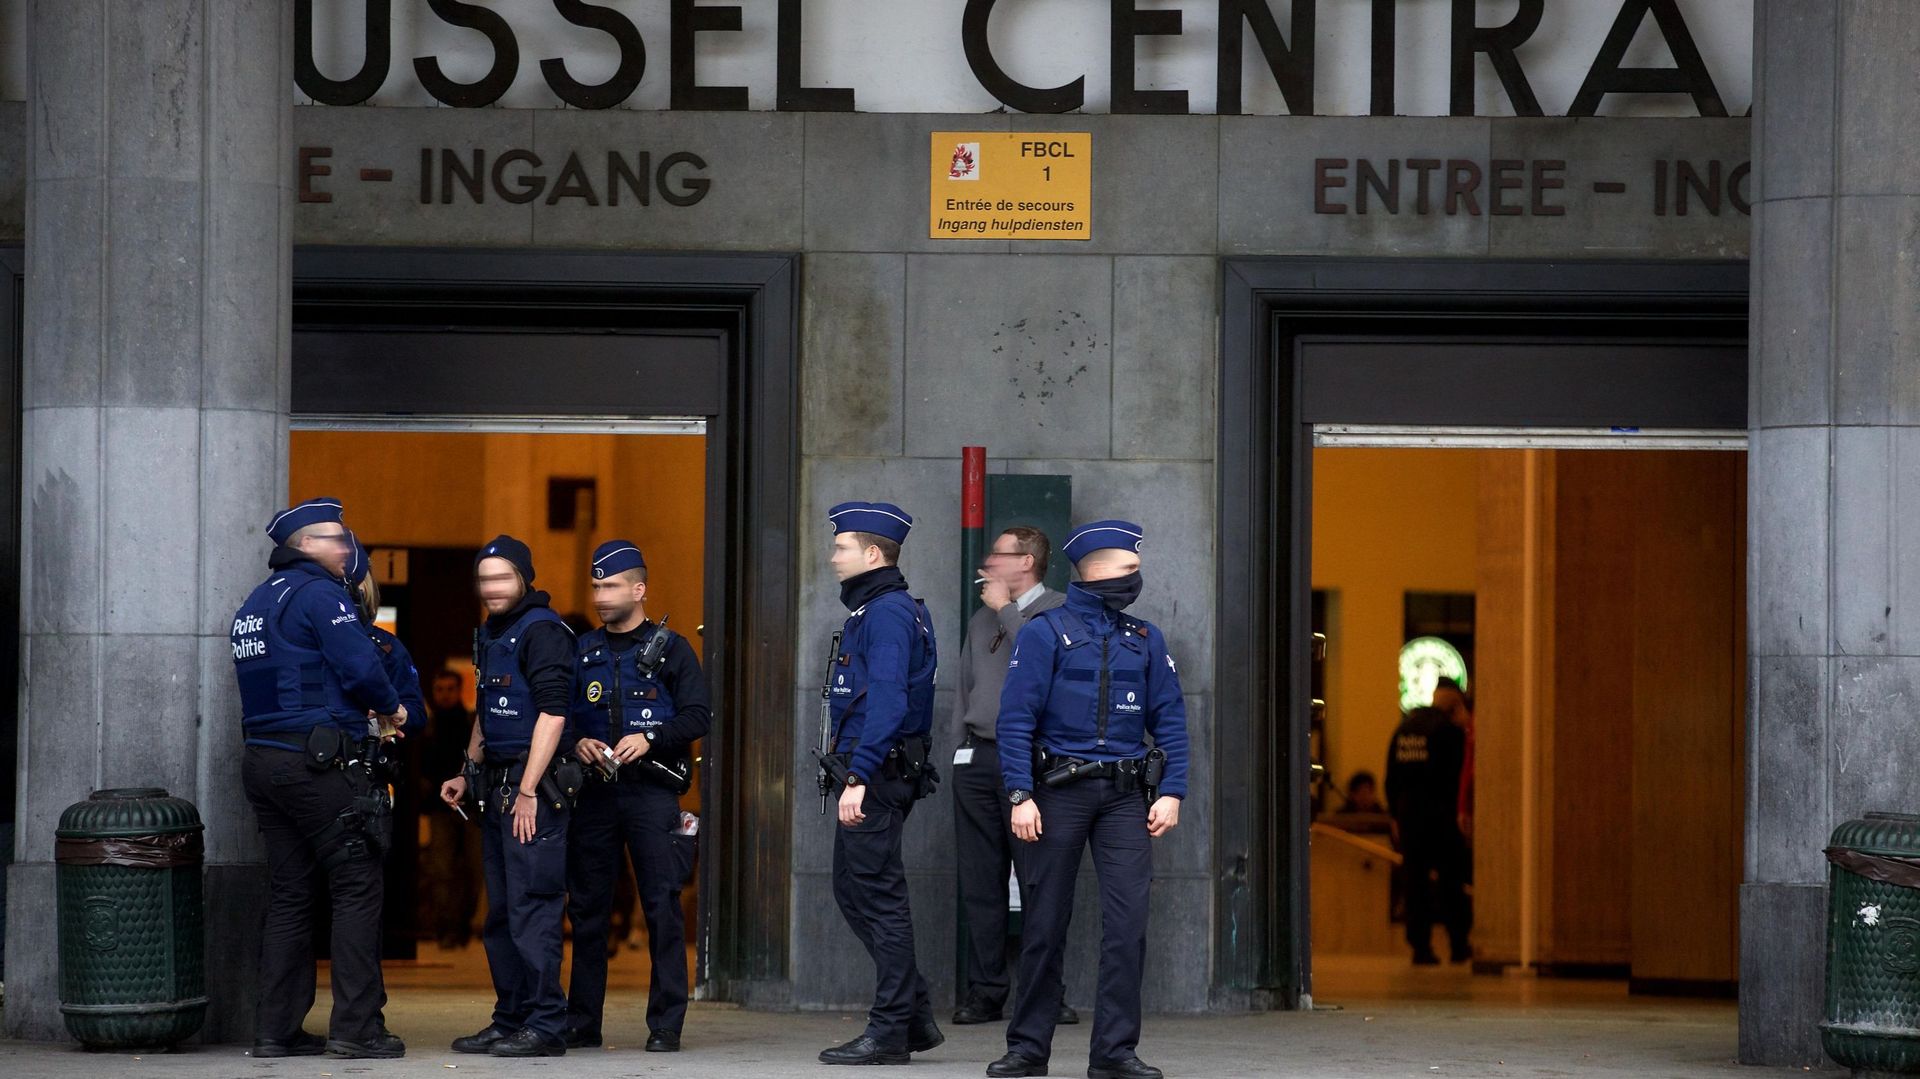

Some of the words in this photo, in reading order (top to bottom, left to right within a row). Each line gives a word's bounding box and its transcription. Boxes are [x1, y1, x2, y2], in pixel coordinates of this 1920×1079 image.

[961, 0, 1752, 118] CENTRA
[1021, 141, 1075, 158] FBCL
[419, 148, 712, 207] INGANG
[1042, 166, 1050, 181] 1
[1314, 157, 1566, 217] ENTREE
[946, 199, 992, 211] Entrée
[996, 200, 1013, 211] de
[1017, 202, 1074, 211] secours
[938, 218, 987, 233] Ingang
[991, 219, 1083, 233] hulpdiensten
[232, 615, 264, 636] Police
[232, 637, 266, 660] Politie
